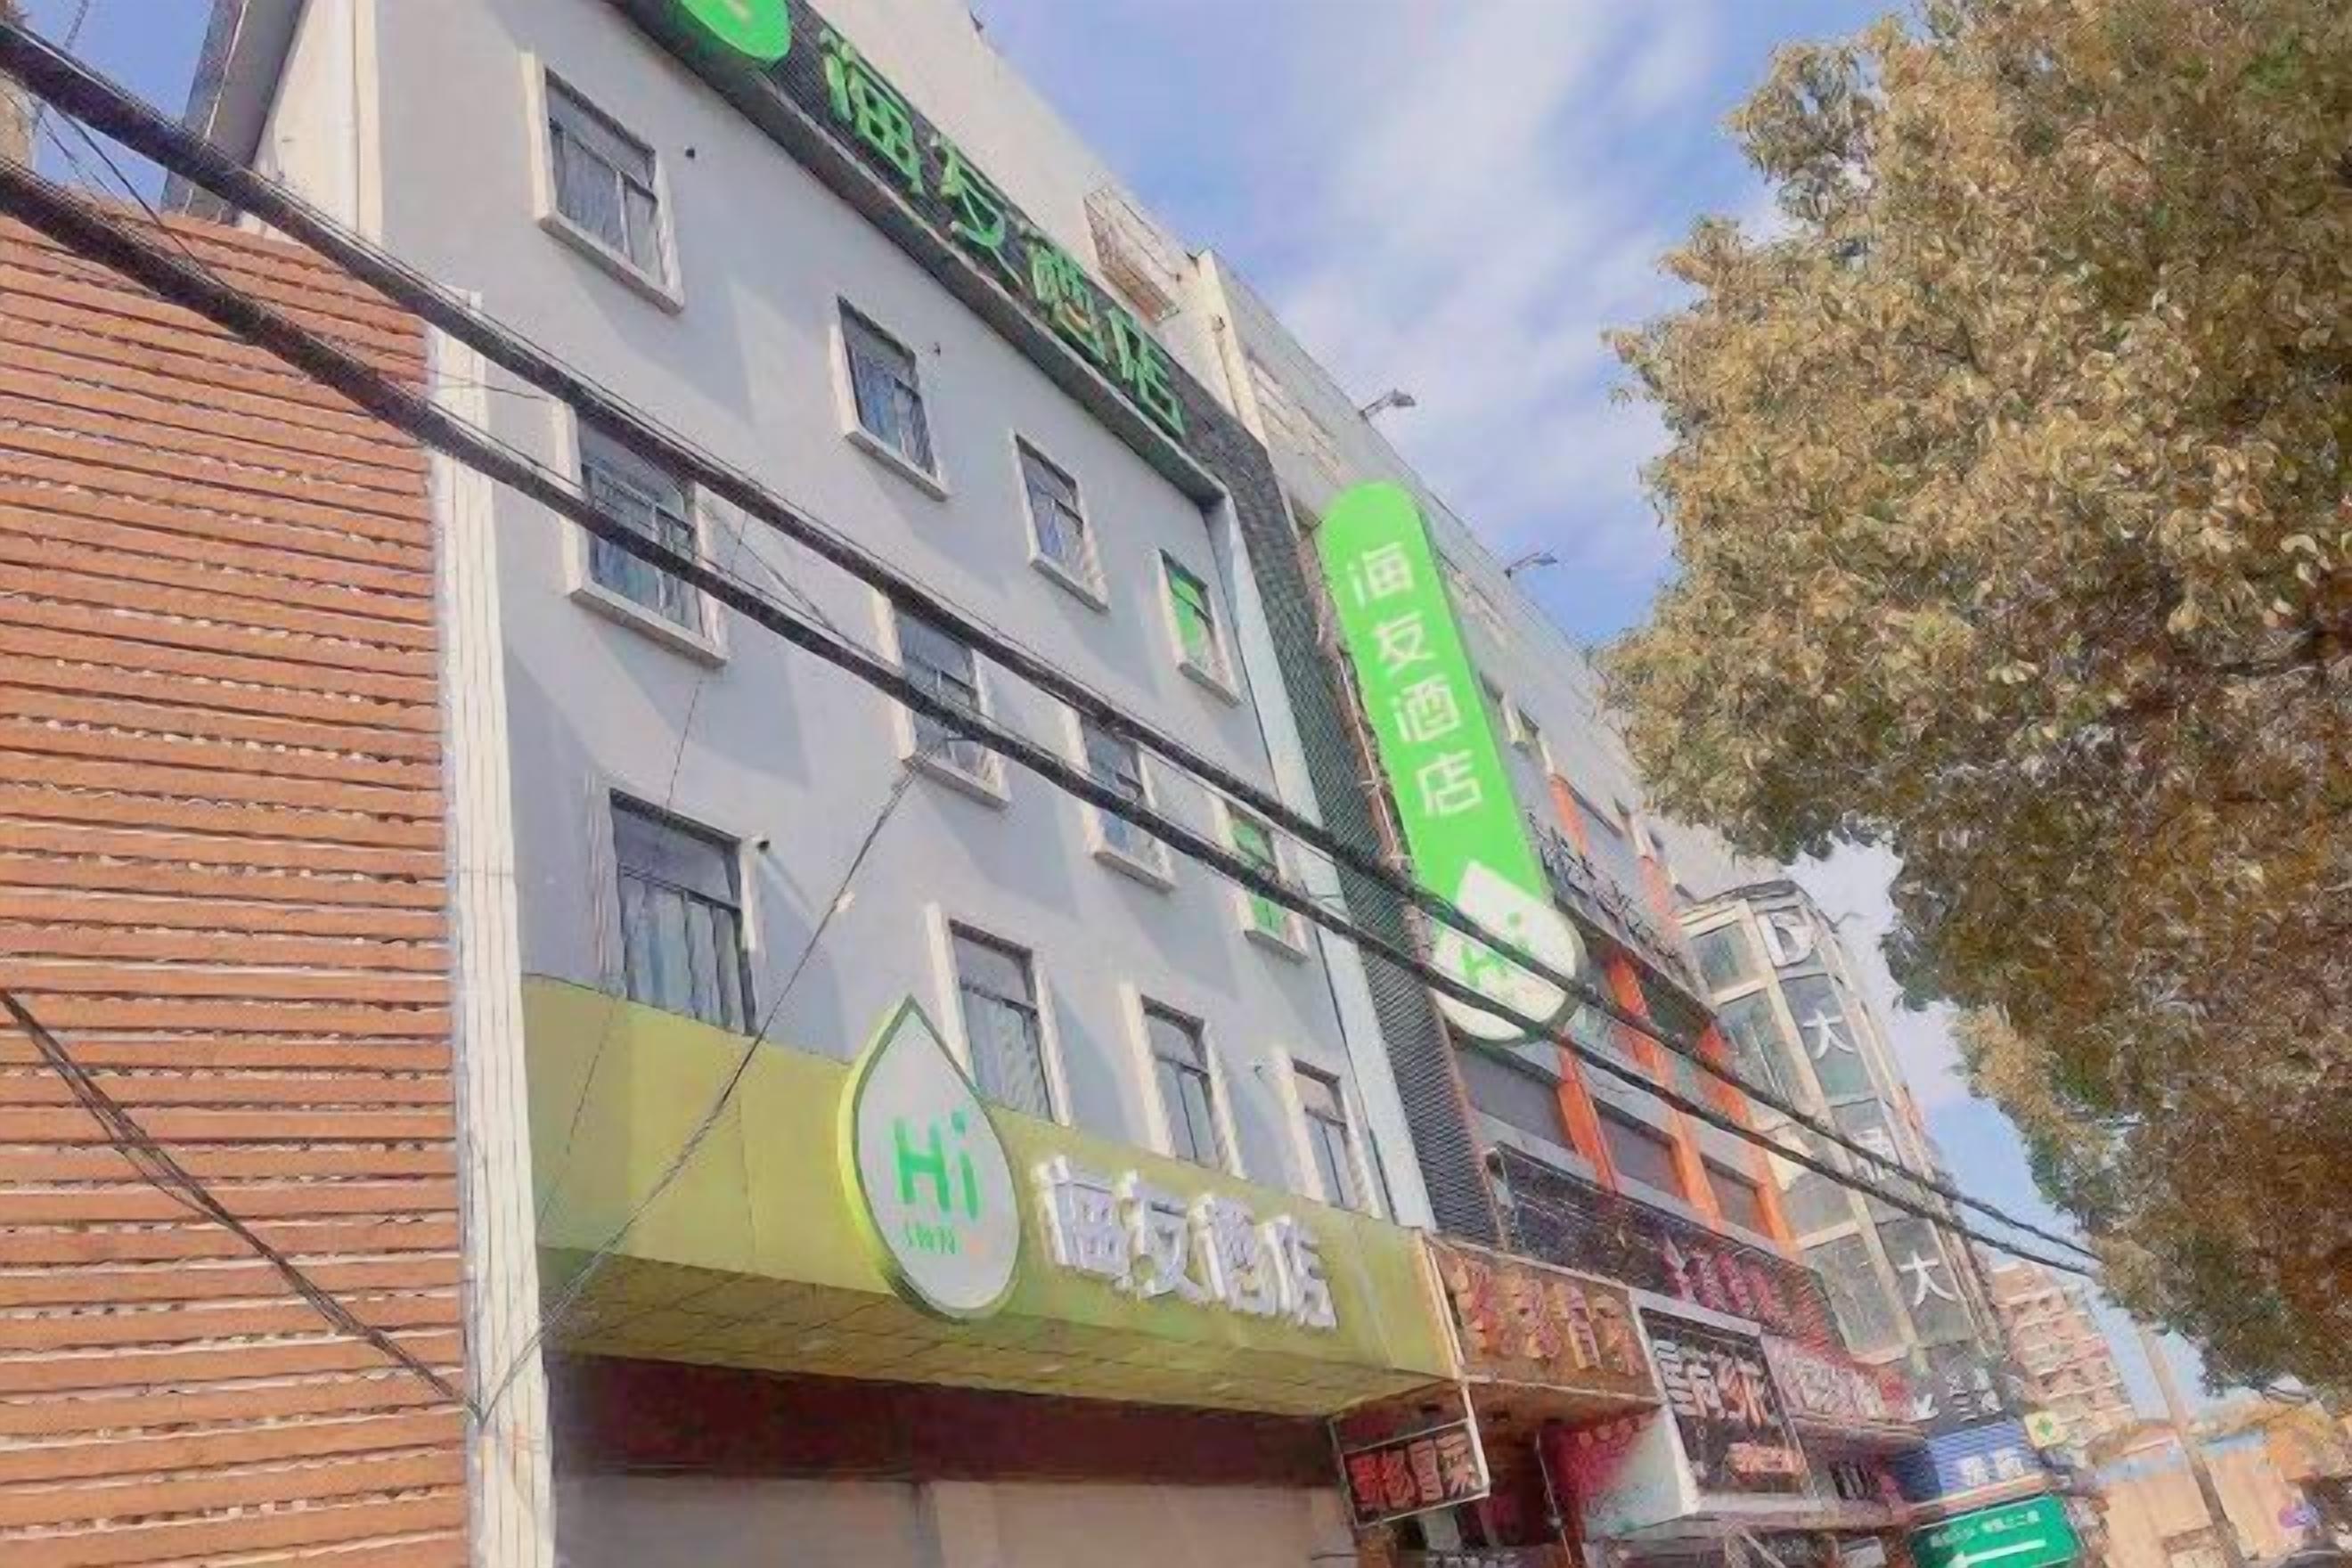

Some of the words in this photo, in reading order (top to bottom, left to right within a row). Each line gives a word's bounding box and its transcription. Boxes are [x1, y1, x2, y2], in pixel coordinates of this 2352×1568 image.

[1345, 541, 1484, 820] 海友酒店
[894, 1108, 978, 1221] Hi
